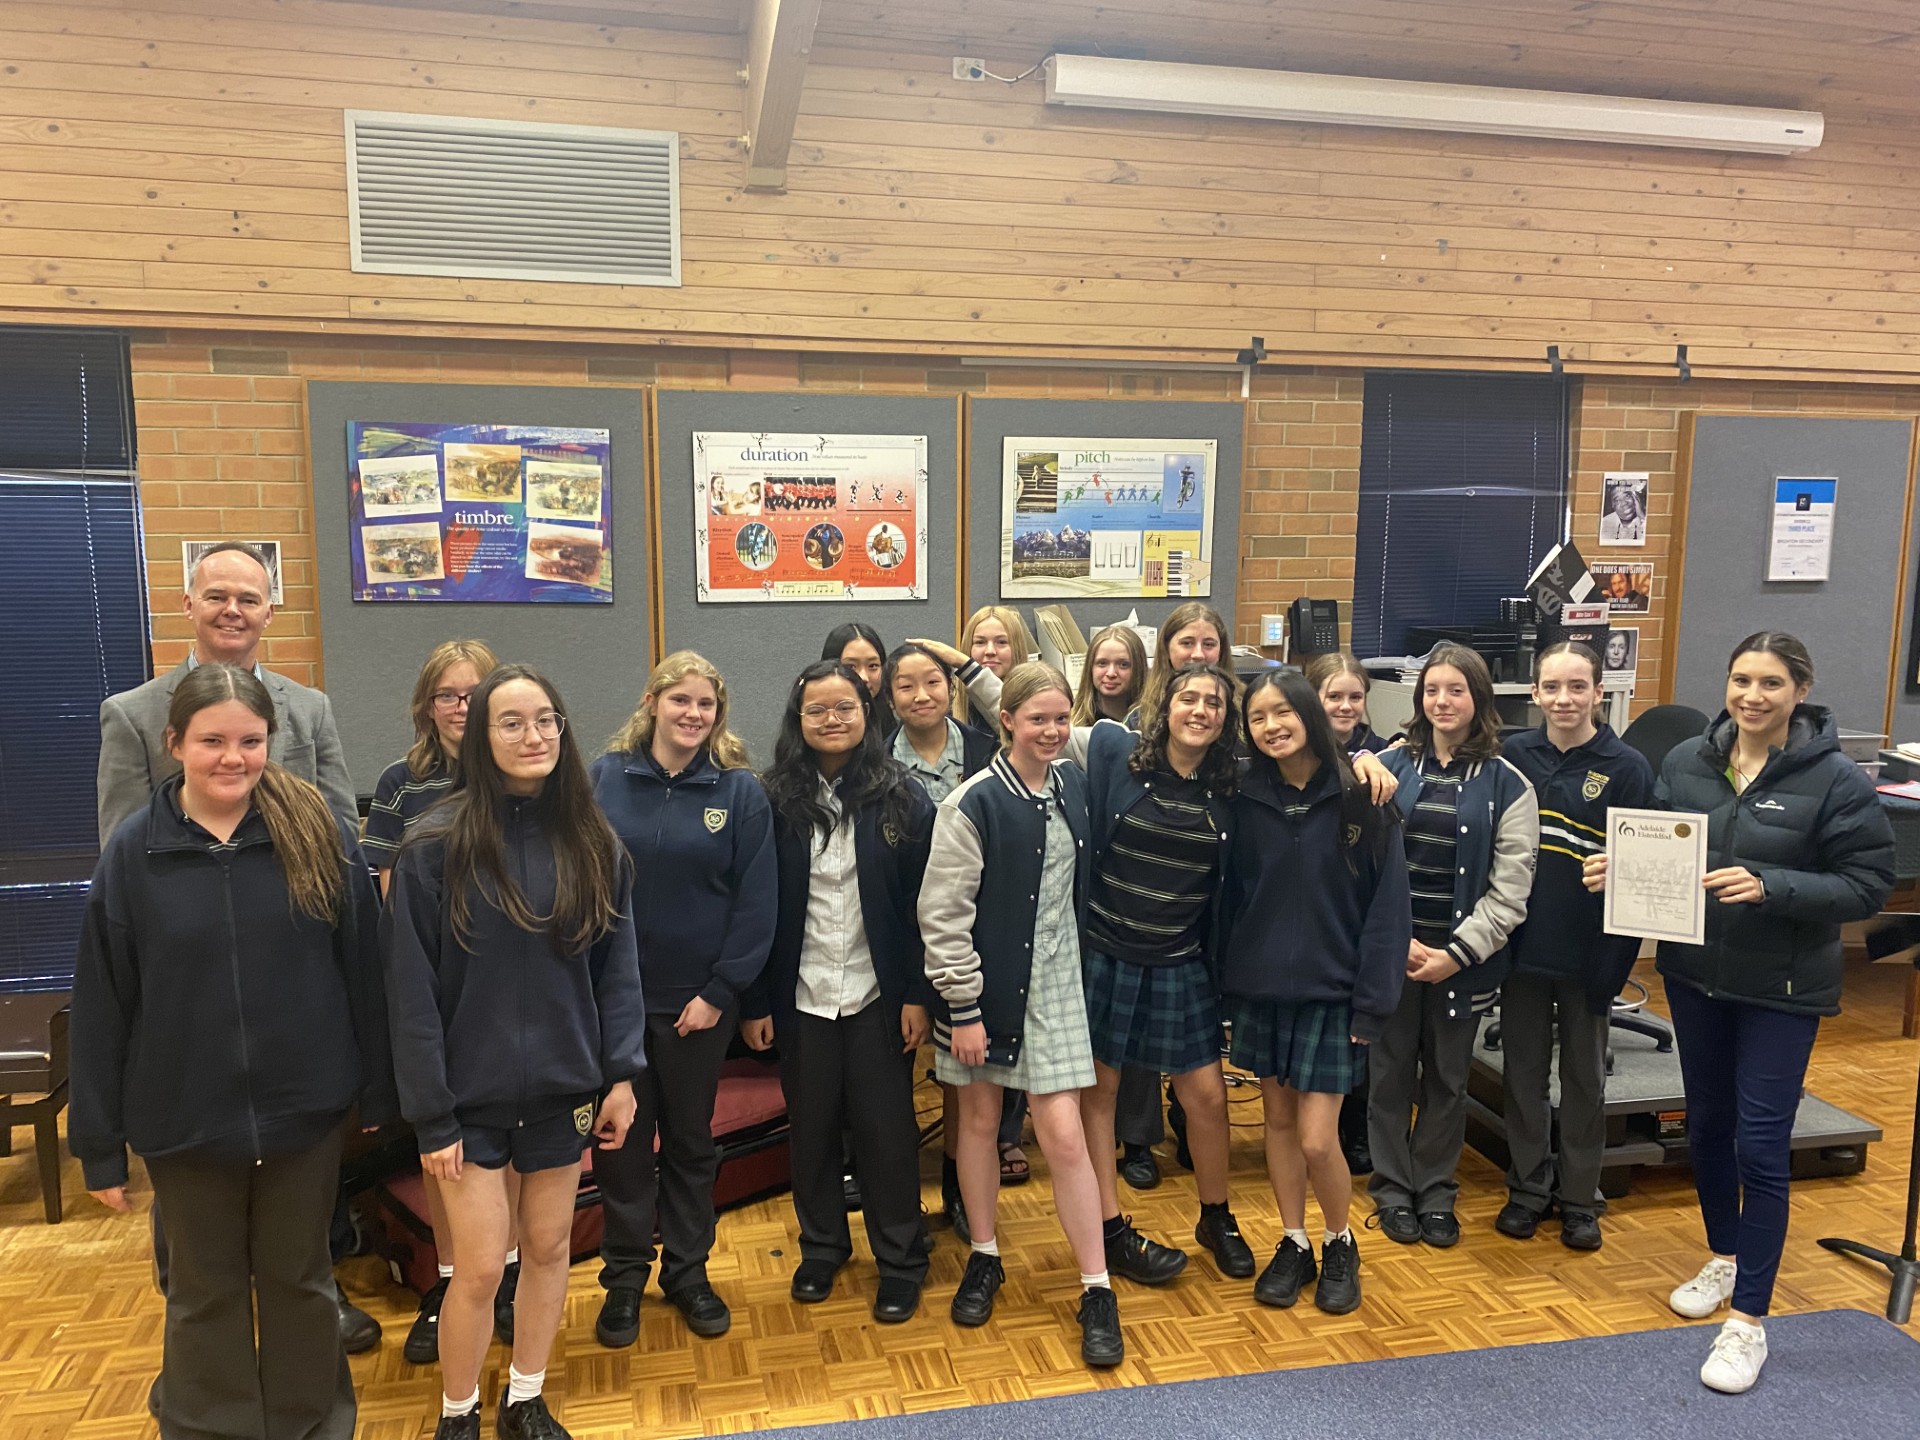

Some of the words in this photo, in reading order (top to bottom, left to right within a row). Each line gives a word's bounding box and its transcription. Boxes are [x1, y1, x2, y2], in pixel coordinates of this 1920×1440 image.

[740, 447, 808, 462] duration
[1075, 451, 1111, 466] pitch
[455, 510, 514, 525] timbre
[1638, 831, 1672, 840] Eisteddfod
